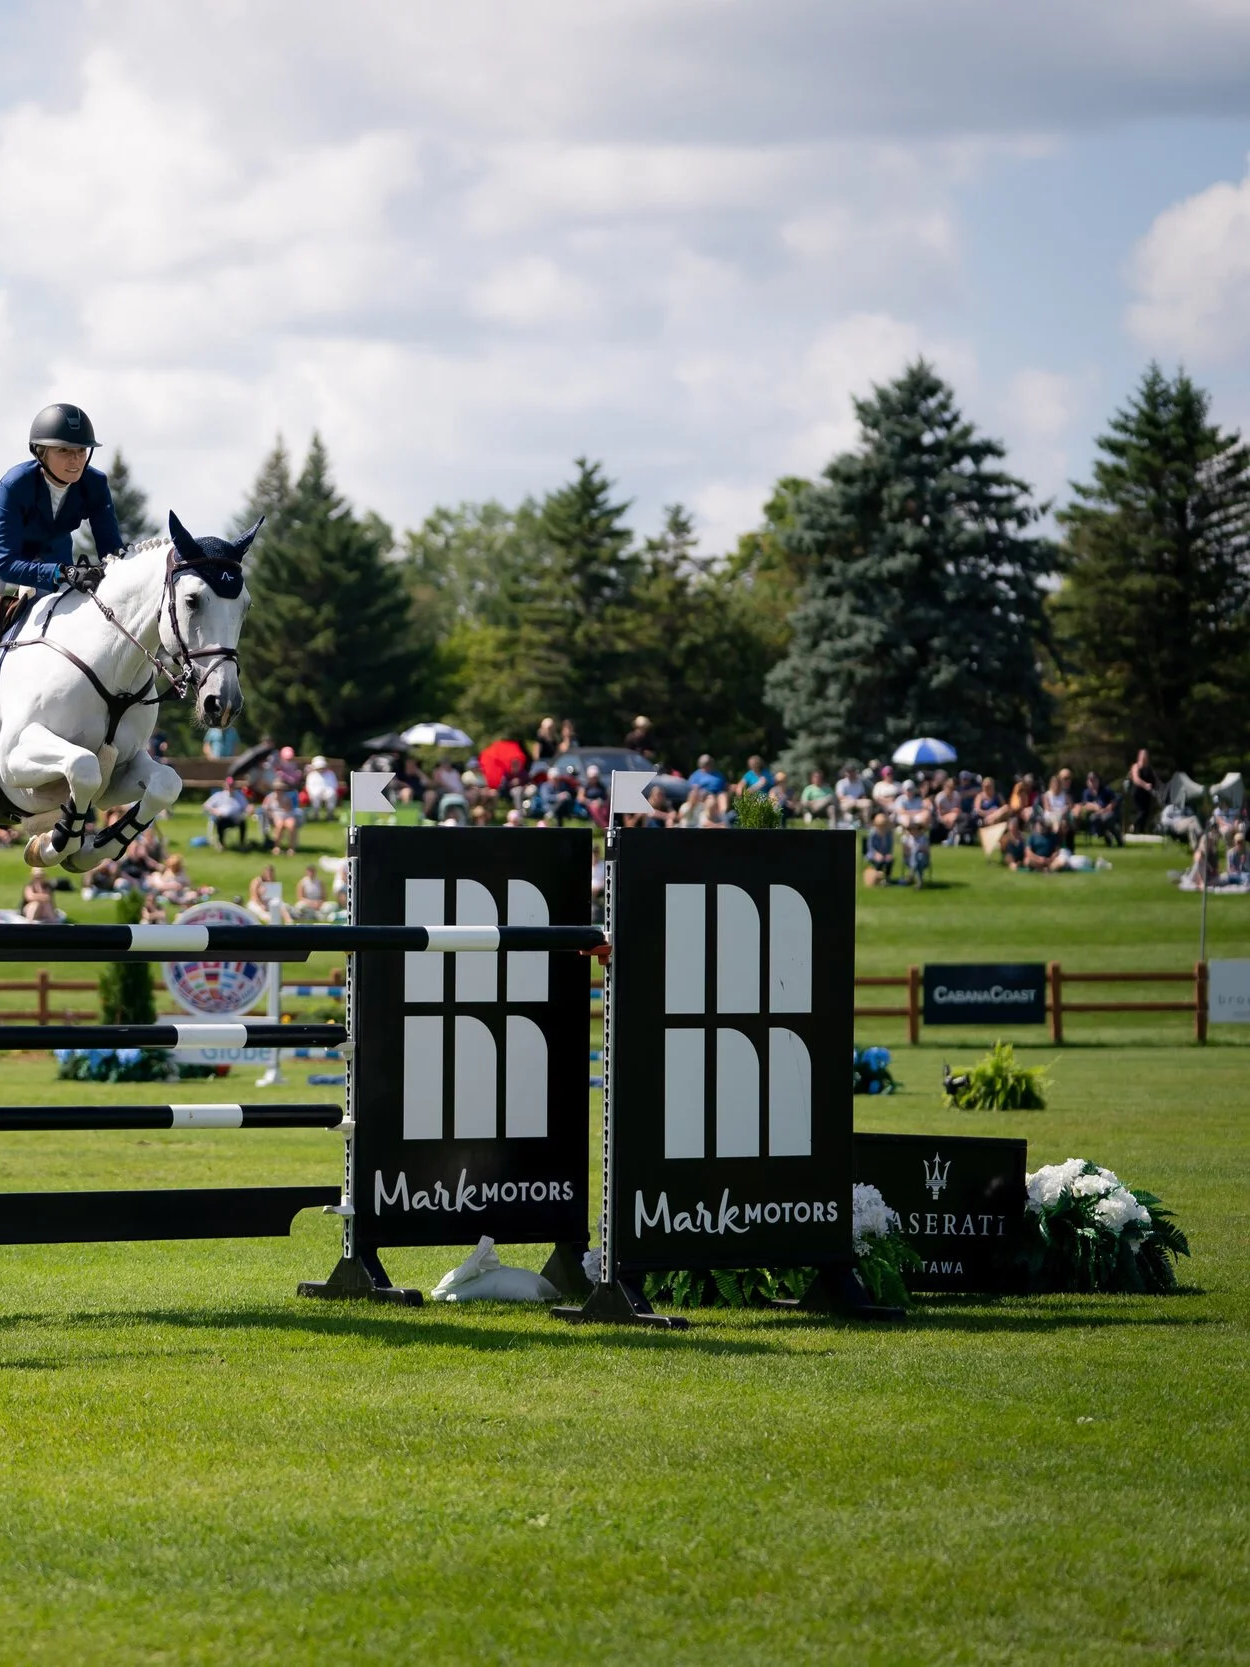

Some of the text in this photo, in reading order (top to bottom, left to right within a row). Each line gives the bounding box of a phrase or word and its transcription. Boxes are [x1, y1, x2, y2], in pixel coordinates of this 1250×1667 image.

[374, 1168, 574, 1216] Mark MOTORS
[635, 1188, 838, 1239] Mark MOTORS
[892, 1212, 1007, 1236] ASERATI
